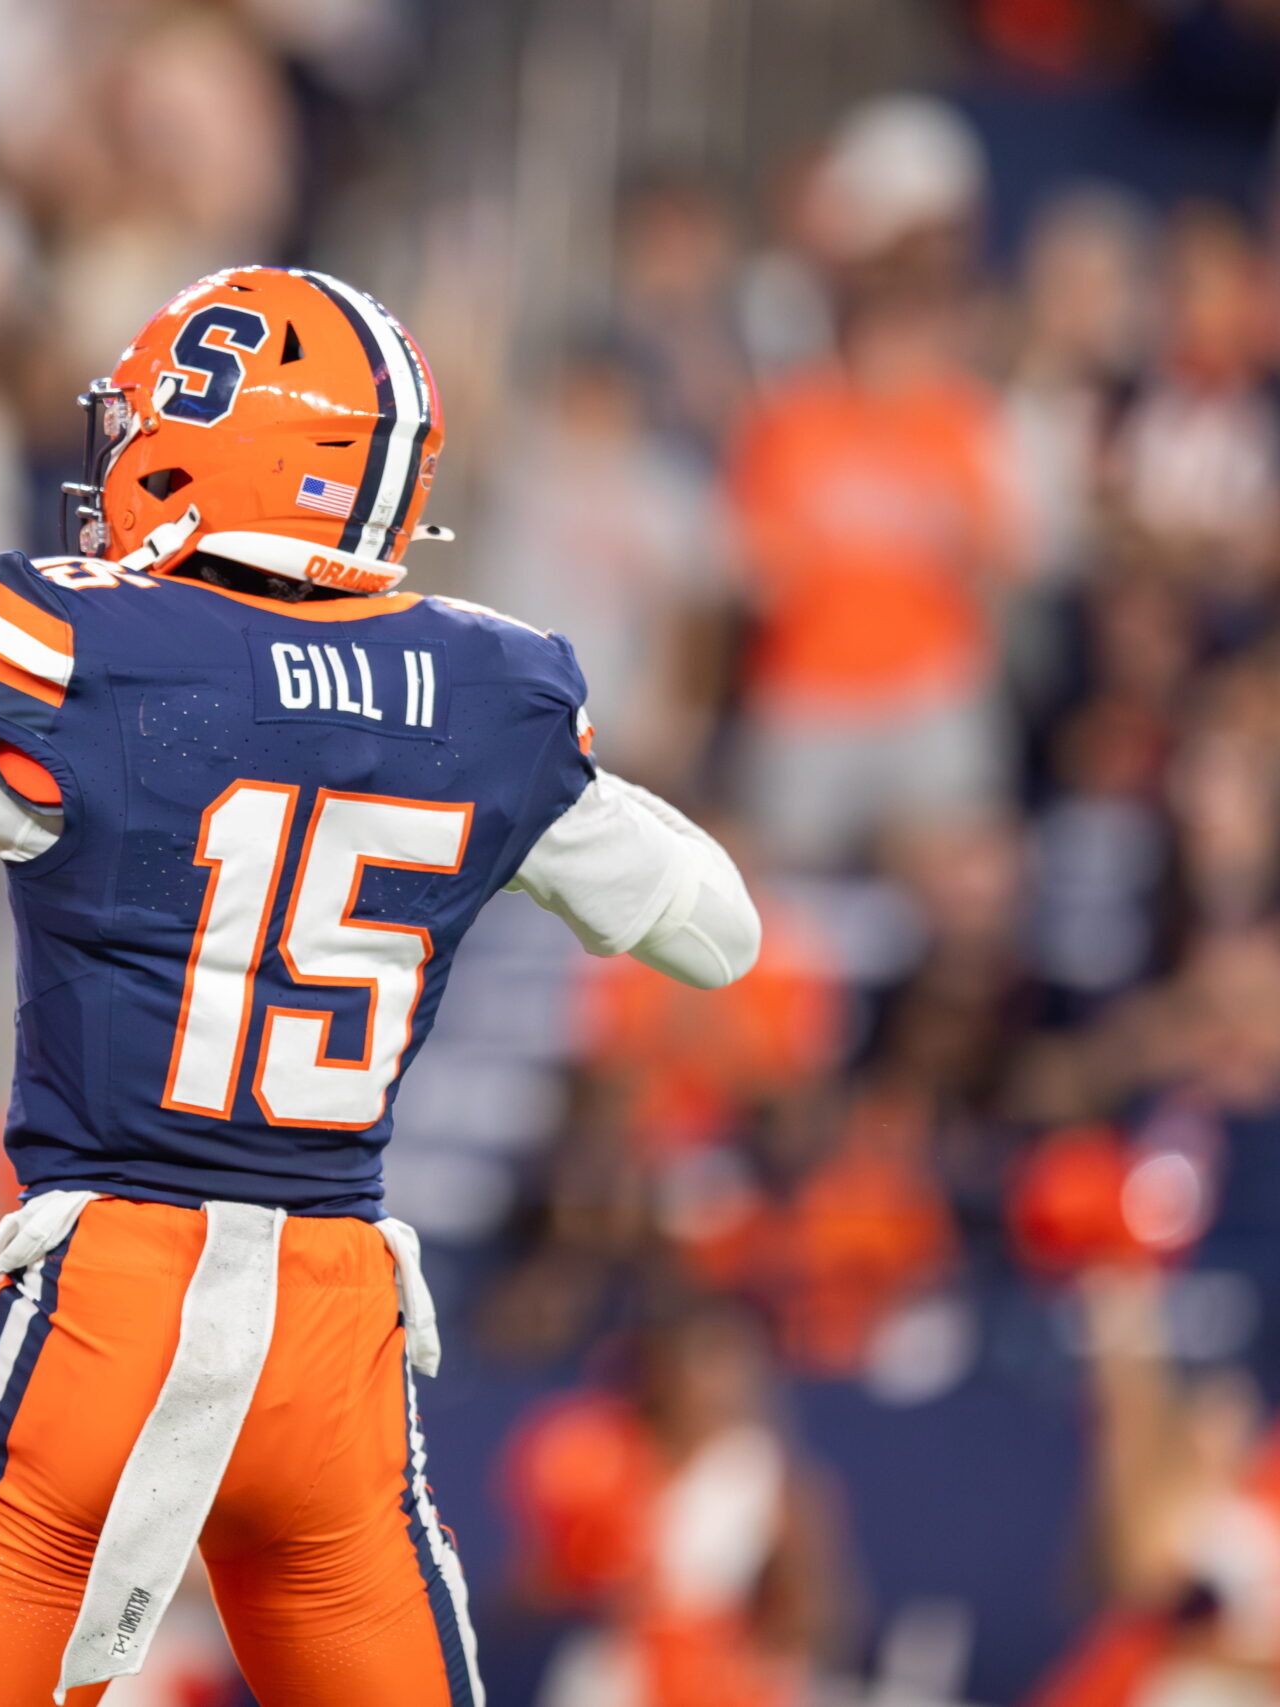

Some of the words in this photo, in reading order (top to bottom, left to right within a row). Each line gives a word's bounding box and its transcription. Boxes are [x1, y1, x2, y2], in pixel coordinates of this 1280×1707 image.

[158, 304, 269, 427] S
[271, 641, 383, 721] GILL
[403, 649, 436, 728] II
[161, 779, 475, 1131] 15
